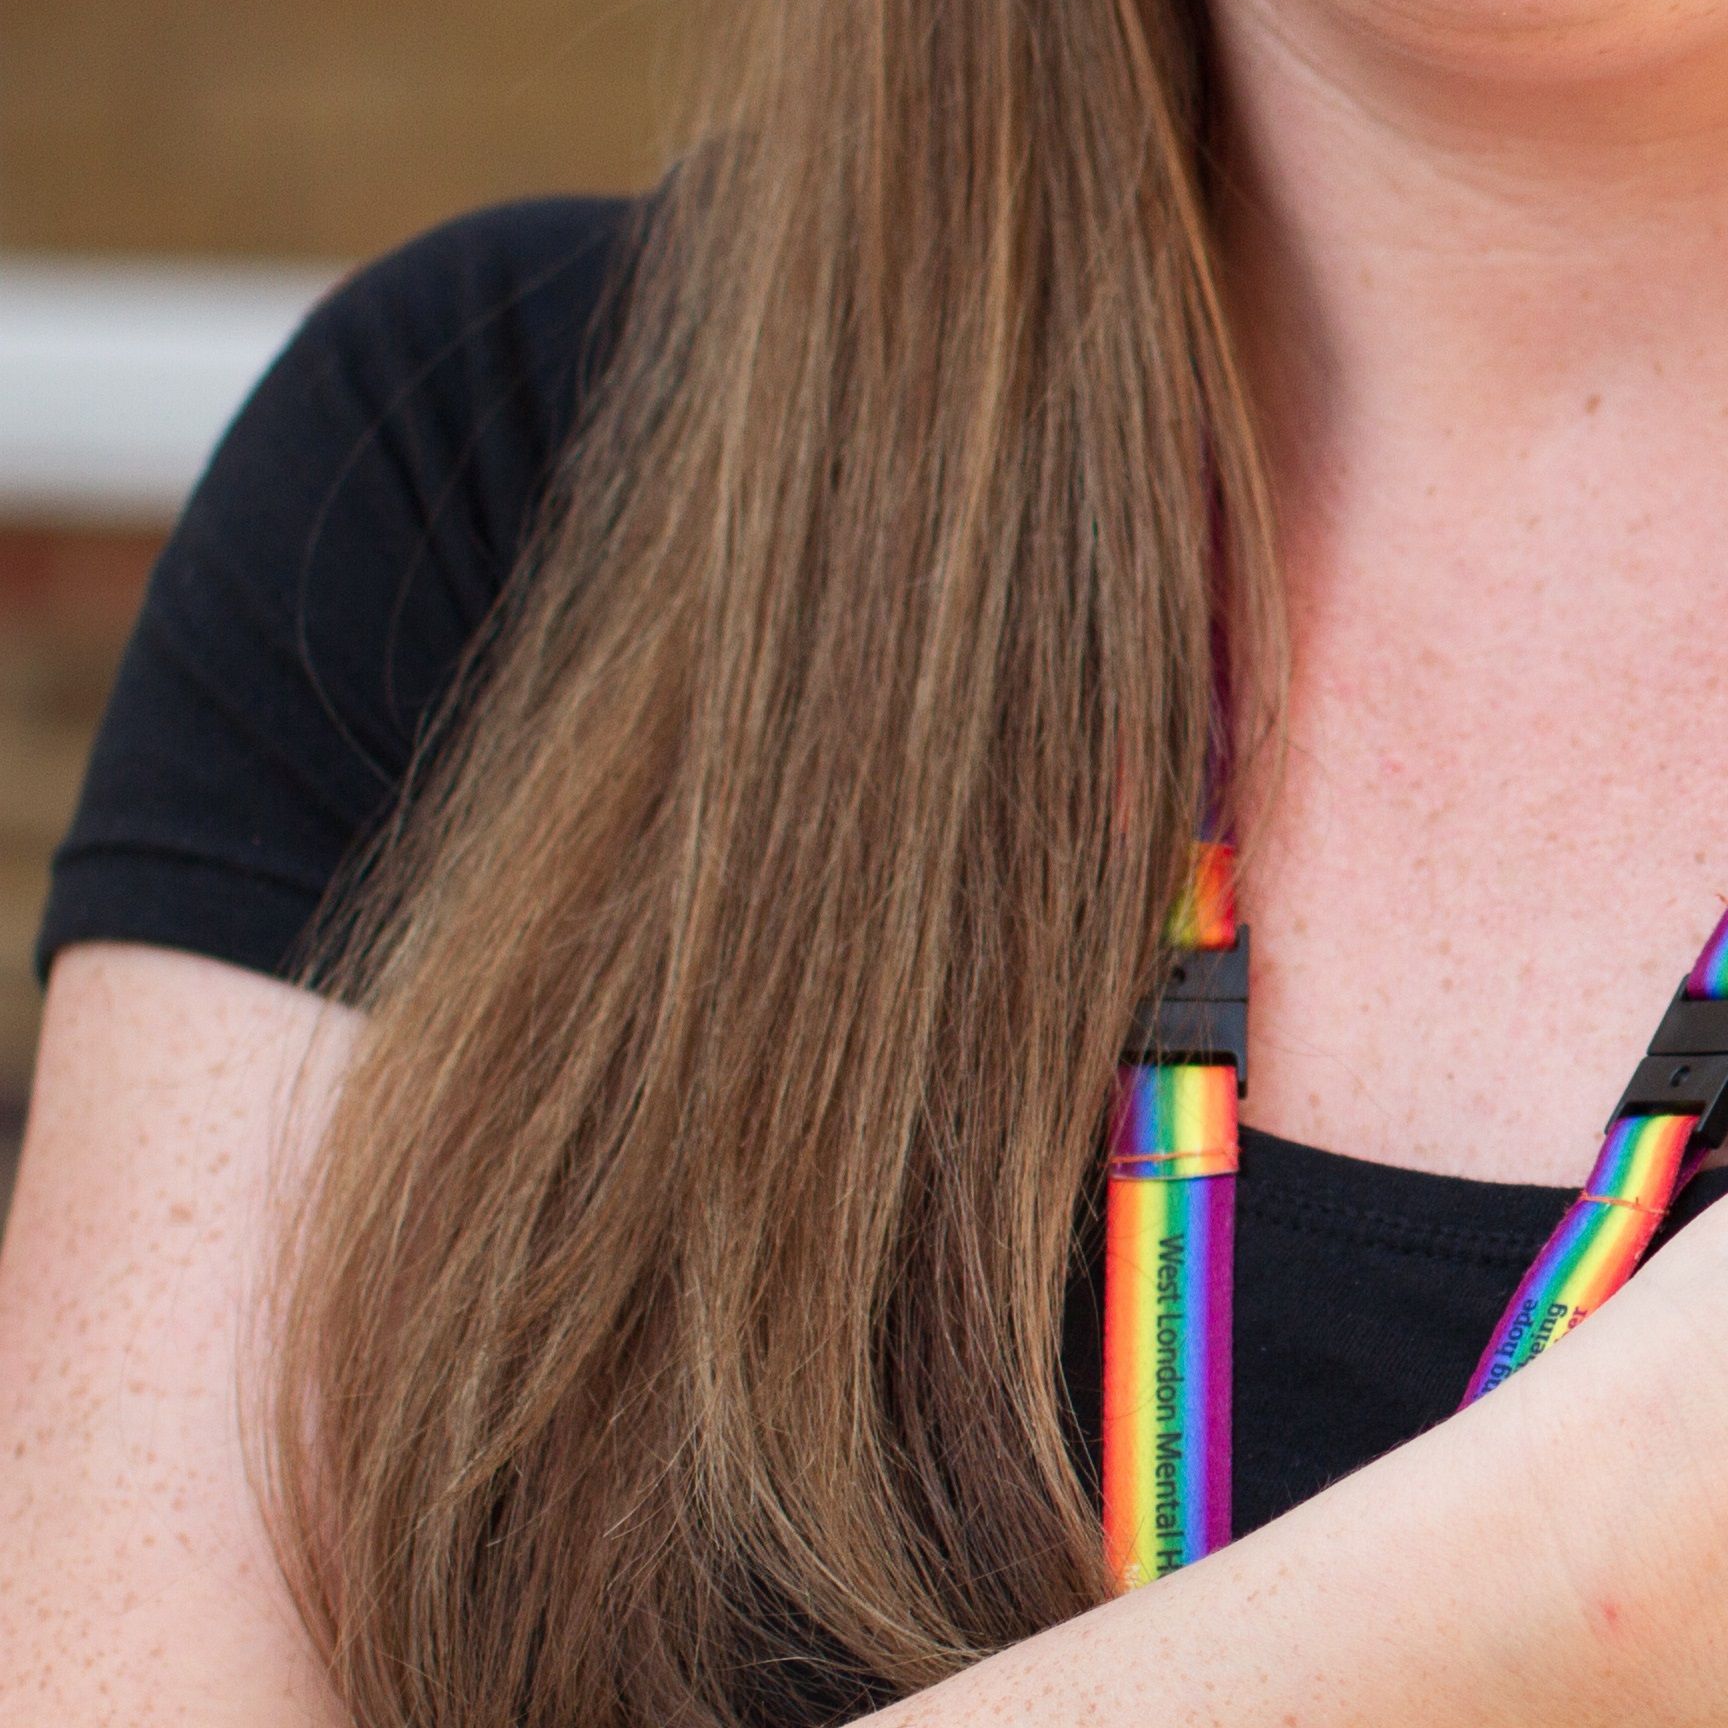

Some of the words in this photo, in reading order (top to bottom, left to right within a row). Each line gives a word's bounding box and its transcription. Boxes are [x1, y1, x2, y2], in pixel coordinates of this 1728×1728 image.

[1157, 1234, 1185, 1304] West
[1155, 1313, 1184, 1421] London
[1495, 1299, 1538, 1358] hope
[1155, 1432, 1185, 1538] Mental
